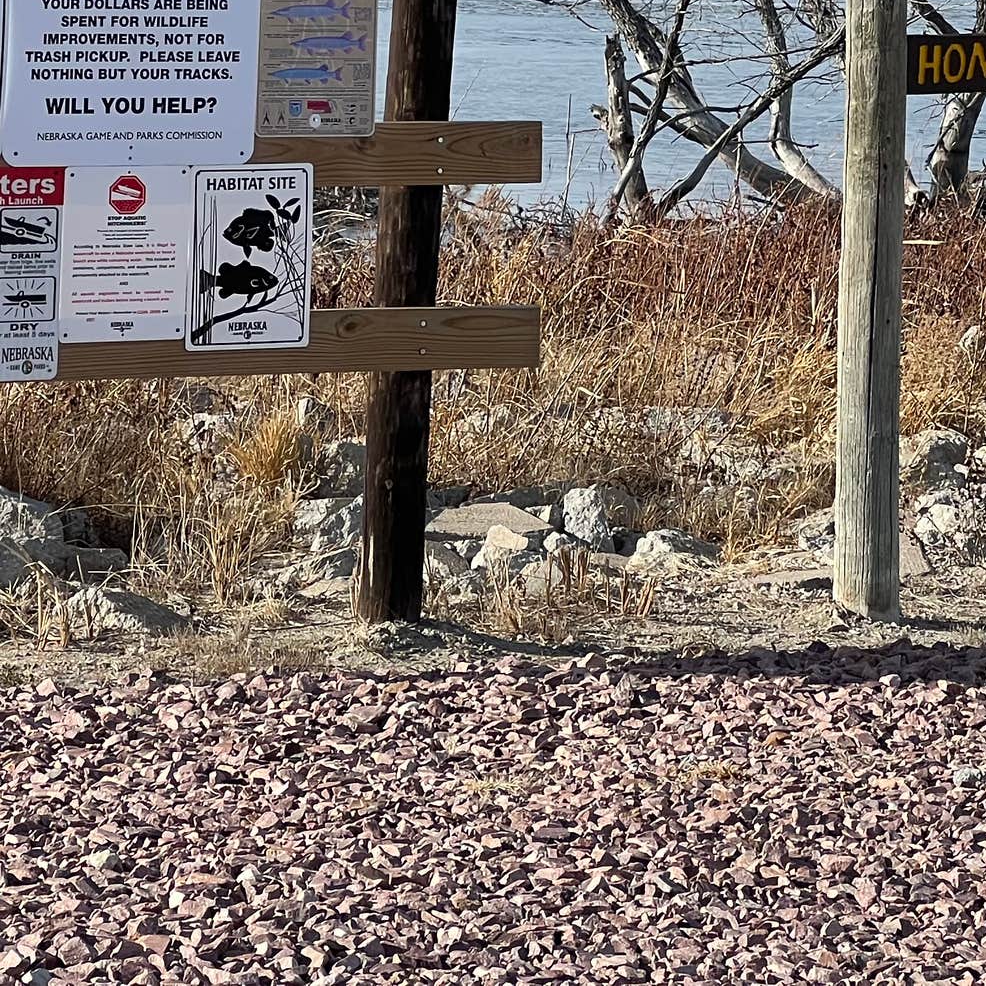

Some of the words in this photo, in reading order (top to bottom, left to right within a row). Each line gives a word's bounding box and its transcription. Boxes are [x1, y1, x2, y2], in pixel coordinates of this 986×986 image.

[85, 0, 149, 10] DOLLARS
[154, 0, 182, 10] ARE
[186, 0, 228, 10] BEING
[61, 16, 106, 27] SPENT
[111, 16, 139, 27] FOR
[143, 17, 208, 27] WILDLIFE
[43, 34, 159, 47] IMPROVEMENTS,
[164, 34, 193, 45] NOT
[198, 34, 224, 45] FOR
[25, 51, 71, 62] TRASH
[76, 51, 130, 62] PICKUP.
[140, 51, 193, 62] PLEASE
[198, 51, 240, 62] LEAVE
[31, 68, 93, 80] NOTHING
[99, 69, 126, 80] BUT
[131, 69, 170, 80] YOUR
[174, 69, 233, 80] TRACKS.
[46, 98, 94, 114] WILL
[102, 98, 145, 114] YOU
[152, 97, 217, 114] HELP?
[37, 132, 83, 141] NEBRASKA
[86, 132, 111, 140] GAME
[113, 132, 134, 140] AND
[136, 132, 163, 140] PARKS
[166, 131, 222, 139] COMMISSION
[207, 178, 264, 190] HABITAT
[269, 177, 296, 190] SITE
[8, 196, 44, 205] Launch
[10, 323, 39, 331] DRY
[228, 321, 268, 331] NEBRASKA
[1, 346, 54, 364] NEBRASKA
